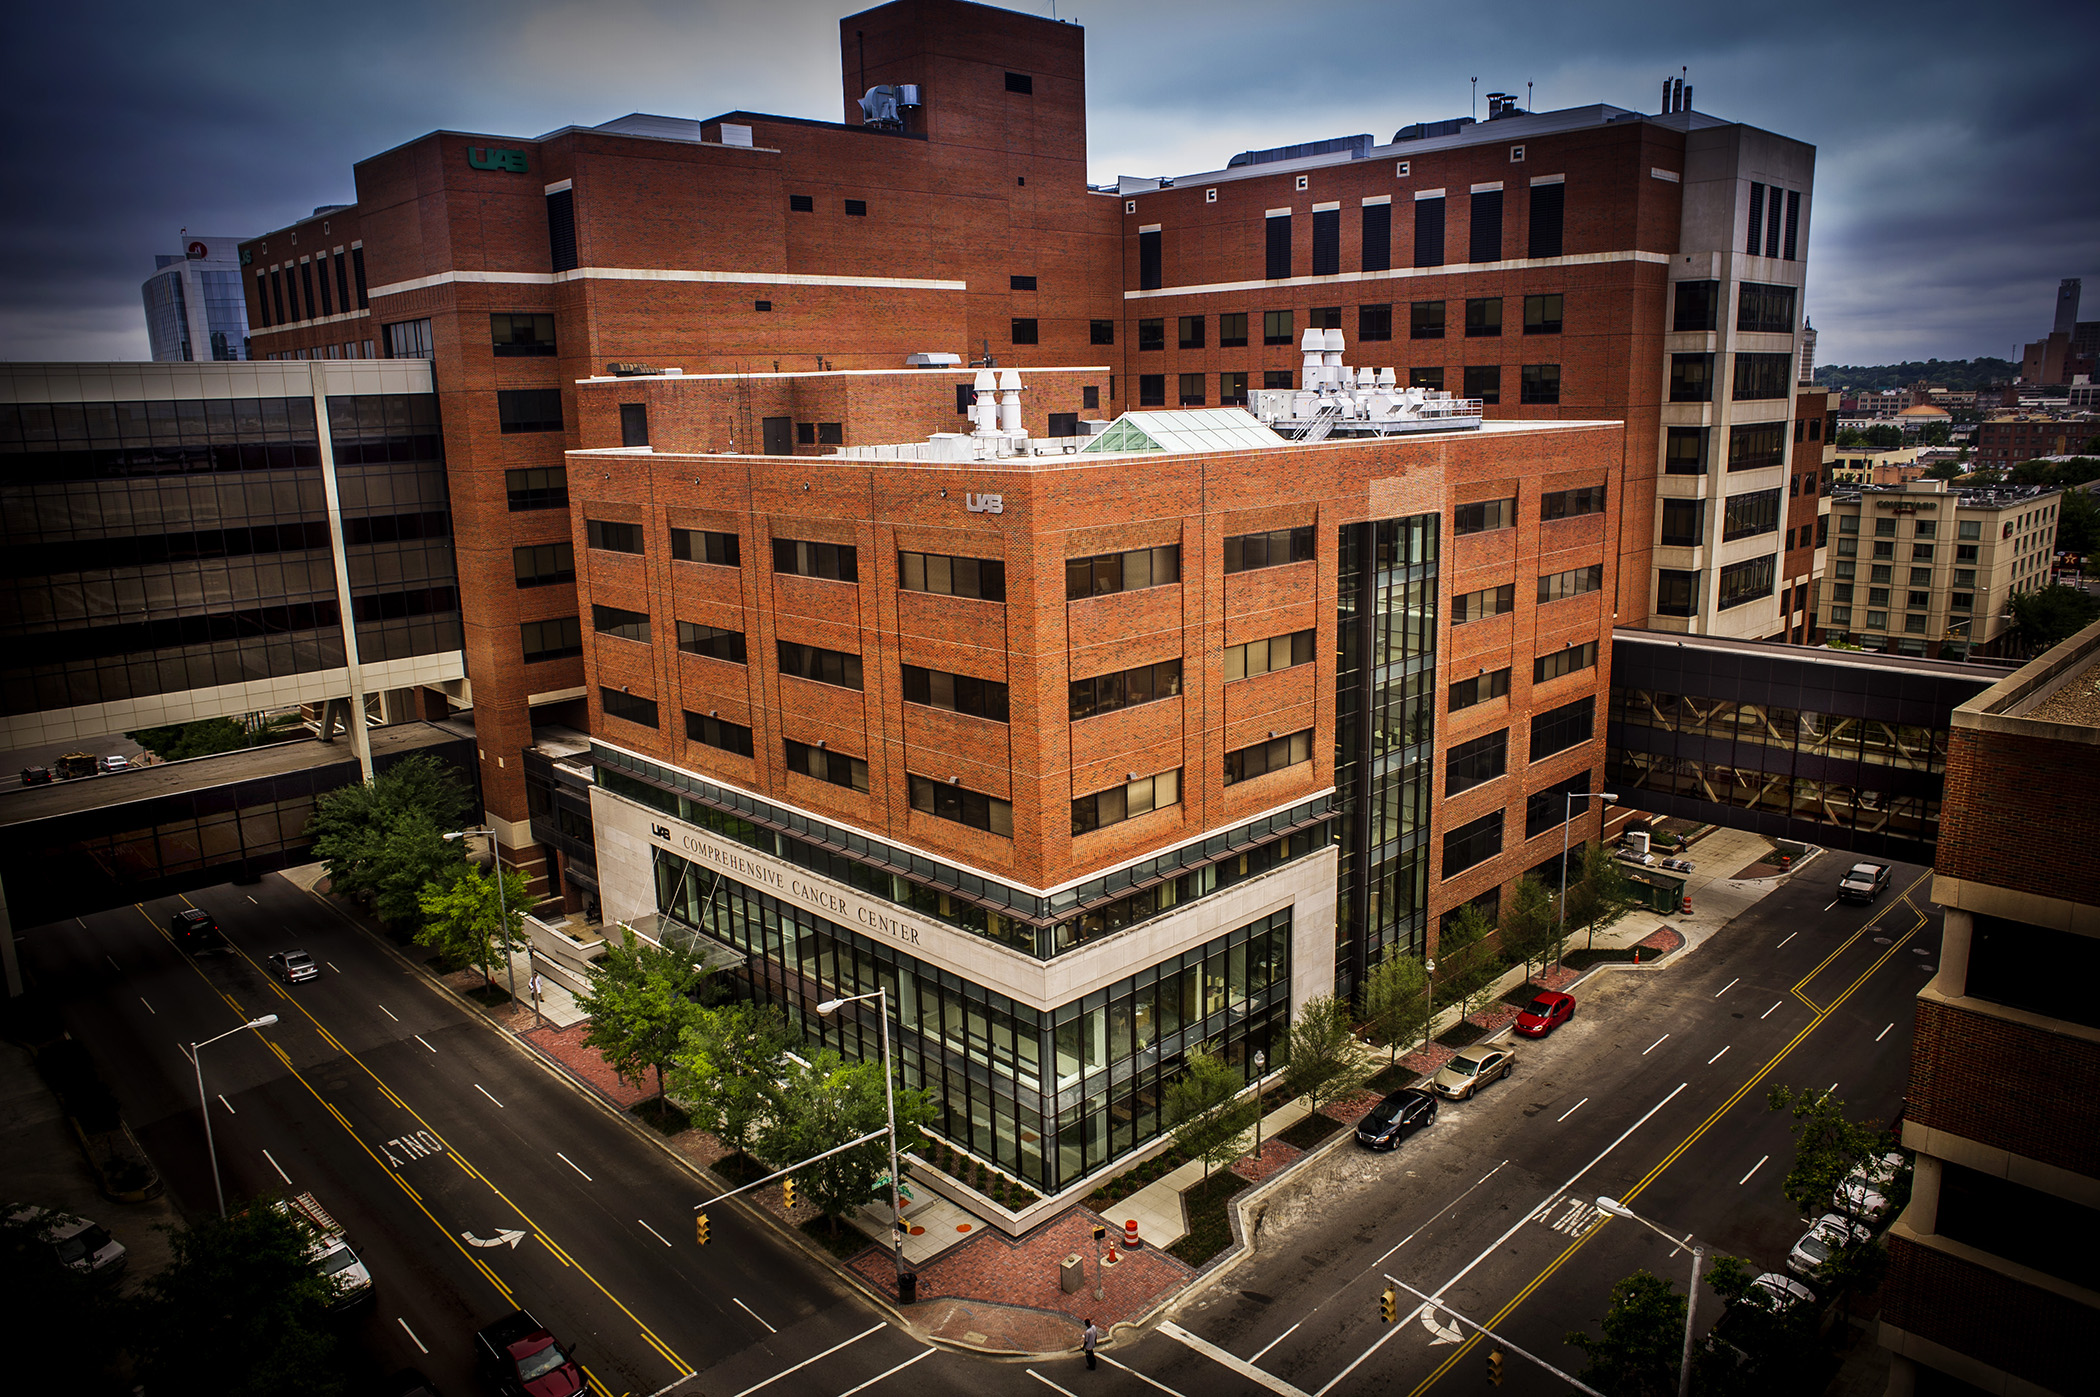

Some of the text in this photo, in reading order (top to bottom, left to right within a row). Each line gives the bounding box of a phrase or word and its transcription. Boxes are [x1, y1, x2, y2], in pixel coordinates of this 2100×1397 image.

[467, 146, 529, 173] UAB
[966, 493, 1004, 514] UAB
[1876, 500, 1937, 510] COURTYARD
[652, 822, 920, 946] UAB COMPREHENSIVE CANCER CENTER
[378, 1130, 443, 1168] ONLY
[1532, 1195, 1603, 1238] ONLY
